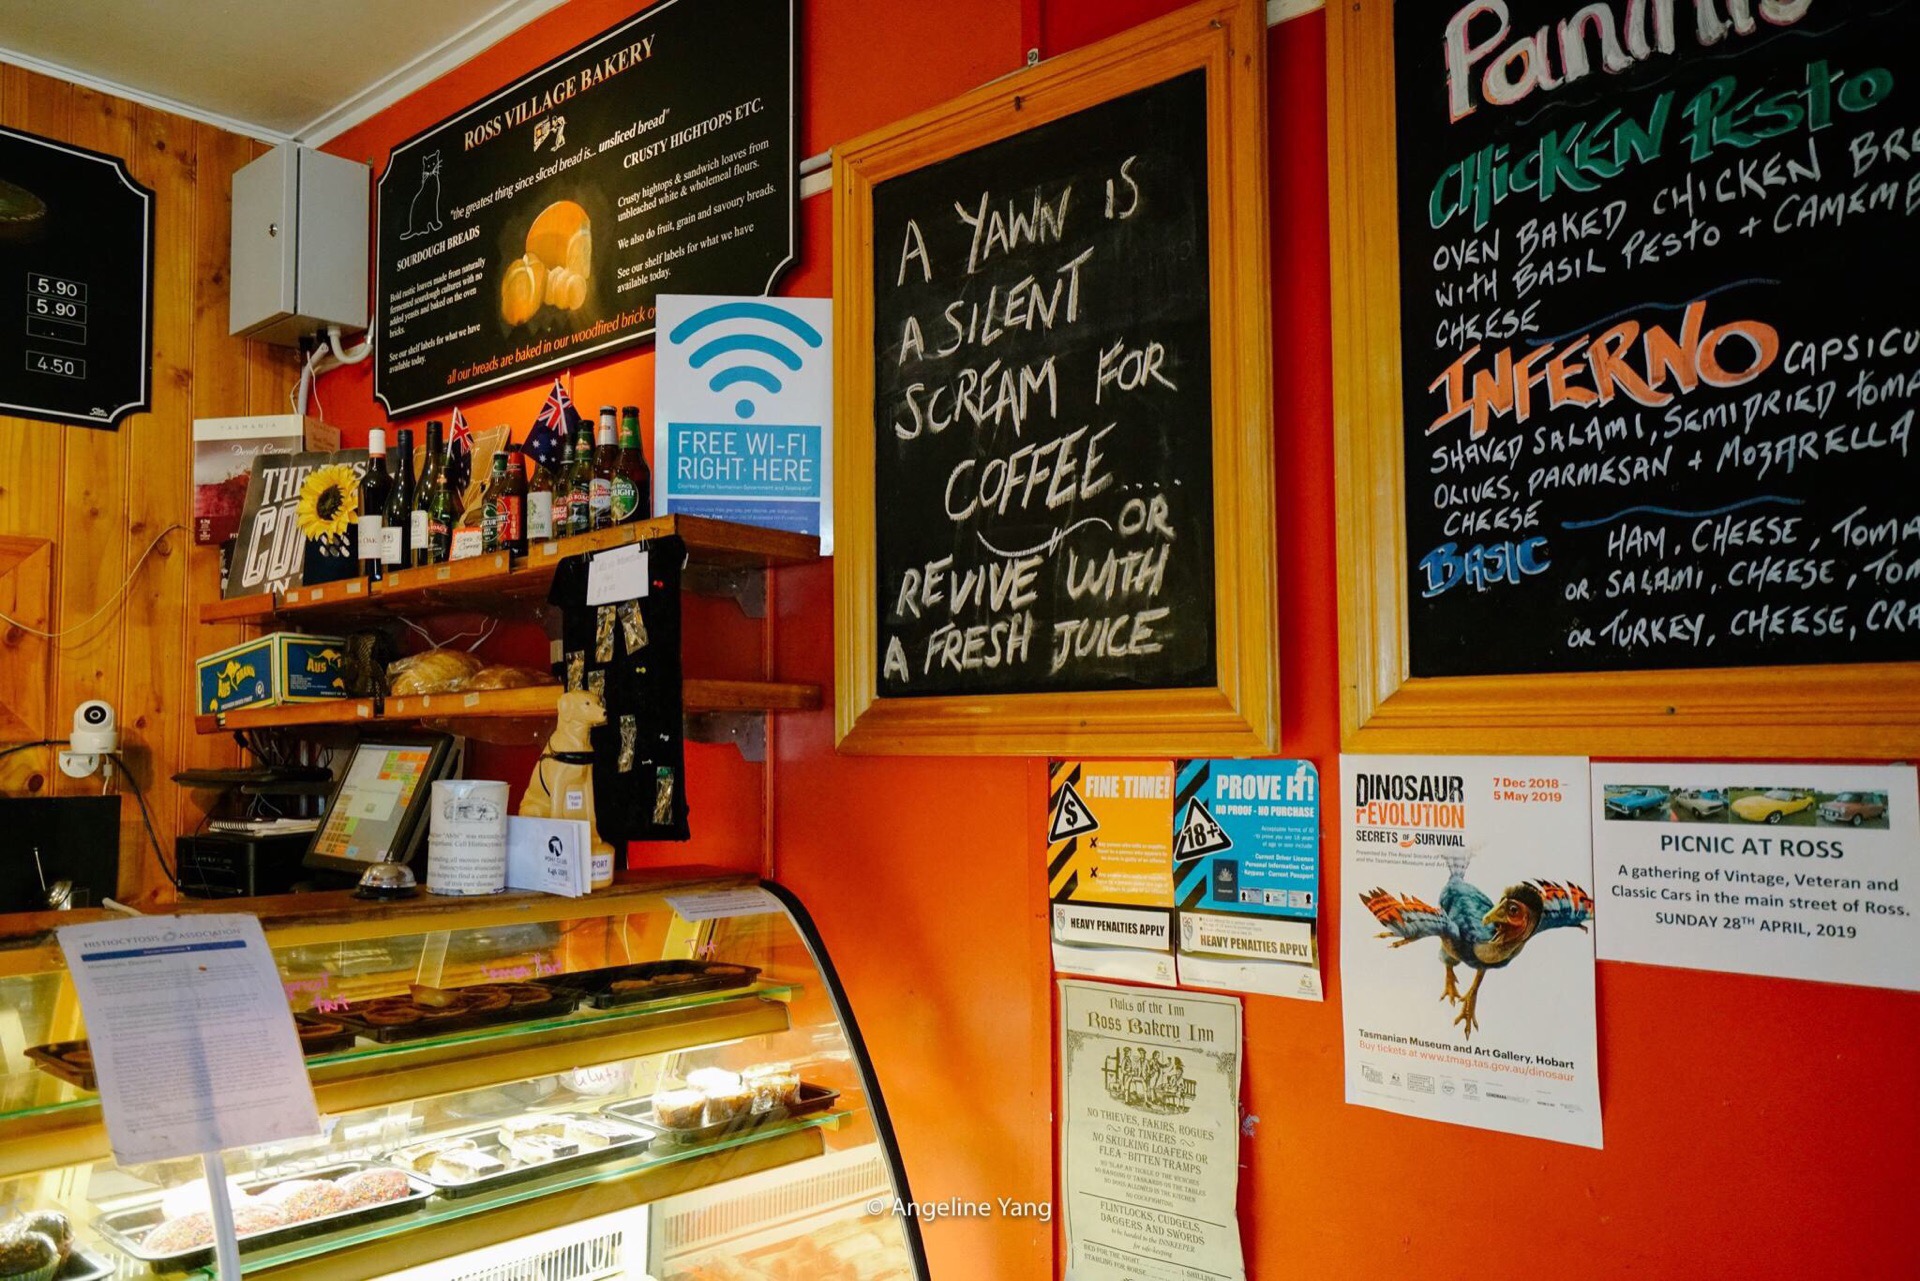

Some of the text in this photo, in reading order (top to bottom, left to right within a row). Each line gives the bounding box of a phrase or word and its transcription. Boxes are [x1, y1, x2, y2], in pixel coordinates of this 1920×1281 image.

[464, 34, 655, 151] ROSS VILLAGE BAKERY
[623, 98, 764, 169] CRUSTY HIGHTOPS ETC.
[465, 192, 494, 219] greatest
[495, 183, 513, 200] thing
[515, 172, 534, 193] since
[535, 159, 558, 183] sliced
[559, 151, 582, 172] bread
[599, 123, 636, 153] unsliced
[617, 139, 769, 208] Crusty hightops & sandwich loaves from
[897, 155, 1139, 287] A YAWN IS
[1432, 136, 1821, 272] OVEN BAKED CHICKEN
[397, 225, 480, 272] SOURDOUGH BREADS
[37, 278, 78, 298] 5.90
[1512, 249, 1606, 299] BASIL
[36, 299, 77, 318] 5.90
[899, 246, 1094, 365] A SILENT
[1436, 300, 1541, 349] CHEESE
[447, 369, 456, 385] all
[457, 367, 470, 381] our
[472, 356, 499, 376] breads
[500, 355, 514, 368] are
[515, 345, 542, 363] baked
[543, 341, 551, 354] in
[553, 336, 570, 351] our
[571, 313, 620, 344] woodfired
[621, 306, 645, 328] brick
[37, 356, 75, 376] 4.50
[1424, 303, 1779, 438] INFERNO
[895, 336, 1178, 440] SCREAM FOR
[678, 431, 806, 456] FREE WI-FI
[1430, 436, 1522, 475] SHAVED
[678, 457, 812, 482] RIGHT HERE
[1529, 447, 1672, 496] PARMESAN
[1688, 455, 1703, 470] +
[1118, 498, 1177, 539] OR
[1444, 501, 1542, 536] CHEESE
[896, 544, 1168, 619] REVIVE WITH
[1419, 536, 1552, 598] BASIC
[1565, 579, 1590, 601] OR
[883, 606, 1172, 683] A FRESH JUICE
[1568, 628, 1596, 648] OR
[1085, 775, 1171, 799] FINE TIME!
[1216, 774, 1281, 800] PROVE
[1356, 773, 1464, 807] DINOSAUR
[1493, 777, 1559, 789] 7 Dec 2018
[1493, 791, 1562, 803] 5 May 2019
[1215, 804, 1314, 818] NO PROOF NO PURCHASE
[1183, 821, 1221, 850] 18+
[1356, 829, 1398, 843] SECRETS
[1415, 833, 1465, 847] SURVIVAL
[1660, 834, 1844, 859] PICNIC AT ROSS
[1618, 864, 1899, 892] A gathering of Vintage, Veteran and
[1611, 885, 1911, 917] Classic Cars in the main street of Ross.
[1071, 917, 1165, 937] HEAVY PENALTIES APPLY
[1655, 911, 1718, 929] SUNDAY
[1760, 919, 1812, 938] APRIL,
[1816, 923, 1857, 939] 2019
[1200, 935, 1308, 957] HEAVY PENALTIES APPLY
[1088, 1011, 1214, 1043] Ross Bakery Inn
[1359, 1029, 1575, 1069] Tasmanian Museum and Art Gallery, Hobart
[1359, 1040, 1575, 1082] Buy tickets at www.tmag.tas.gov.au/dinosaur
